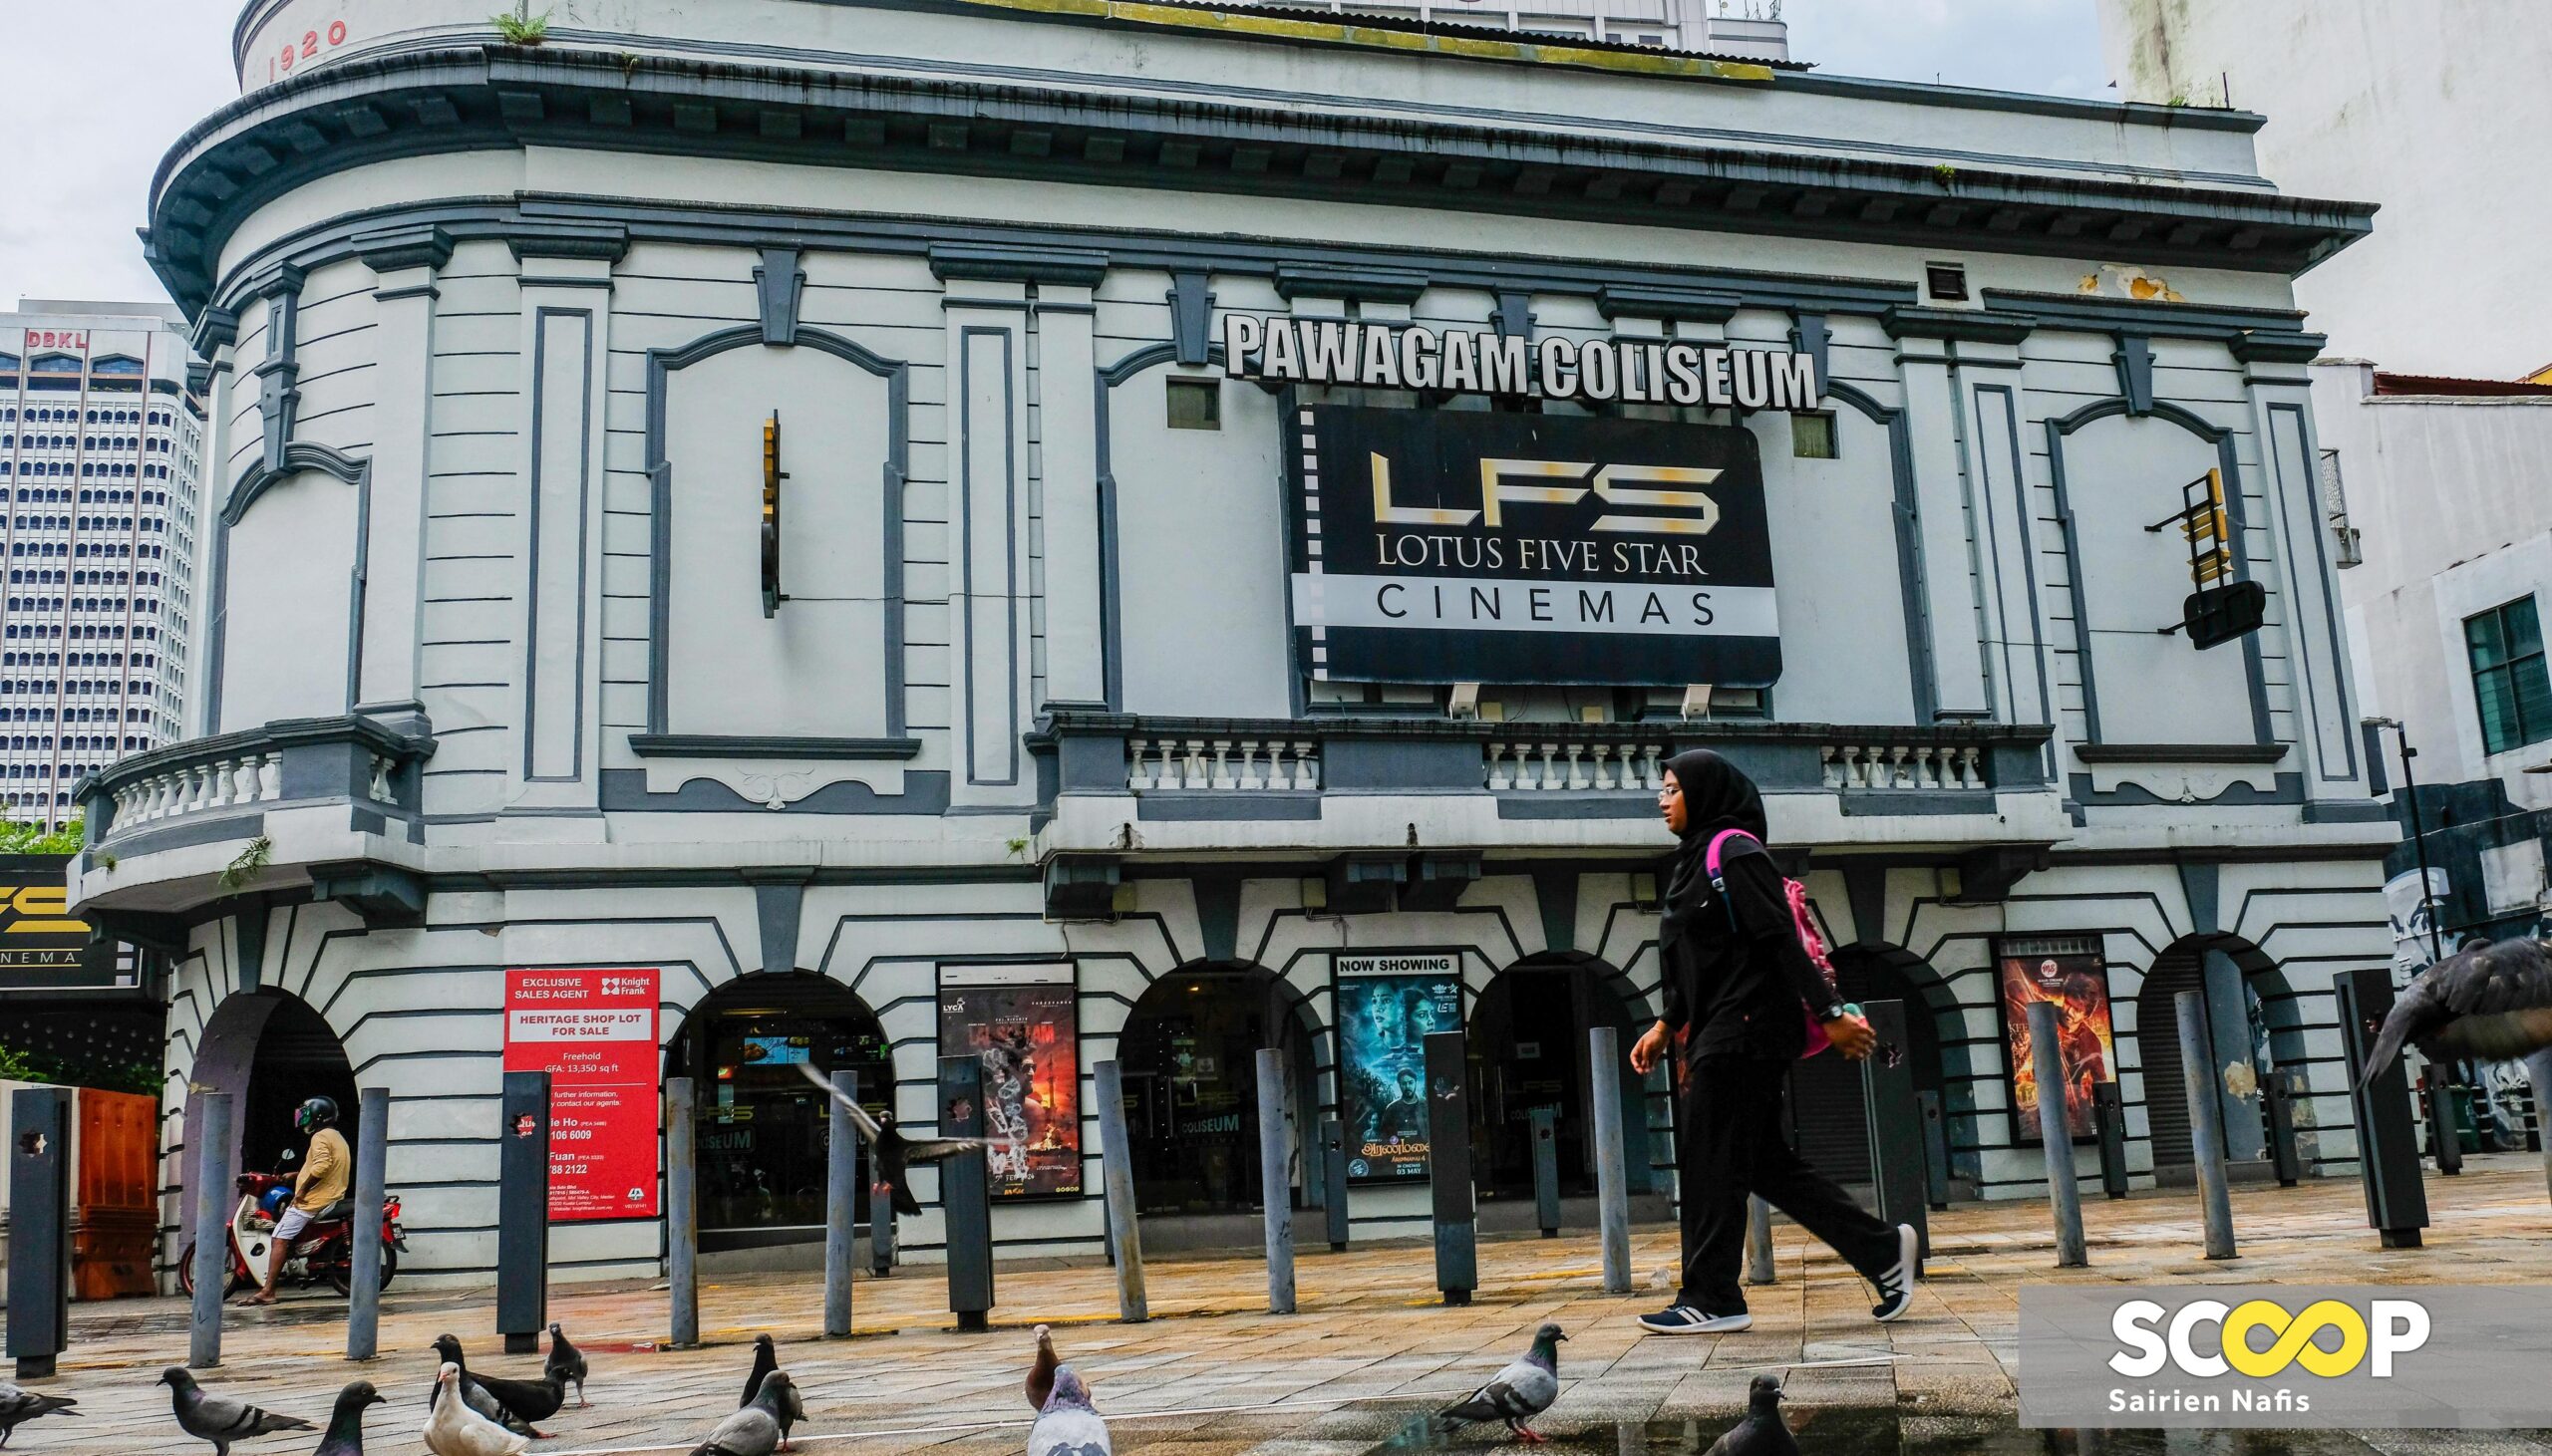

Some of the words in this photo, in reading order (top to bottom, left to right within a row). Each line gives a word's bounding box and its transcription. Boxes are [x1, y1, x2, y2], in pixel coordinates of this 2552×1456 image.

[269, 20, 346, 83] 1920
[27, 331, 87, 349] DBKL
[1223, 314, 1528, 396] PAWAGAM
[1538, 336, 1821, 412] COLISEUM
[1371, 450, 1725, 536] LFS
[1376, 533, 1504, 569] LOTUS
[1518, 538, 1599, 572] FIVE
[1612, 542, 1709, 577] STAR
[1377, 582, 1716, 627] CINEMAS
[1339, 960, 1375, 972] NOW
[1379, 959, 1450, 971] SHOWING
[522, 978, 582, 988] EXCLUSIVE
[621, 977, 650, 988] Knight
[514, 990, 549, 1000] SALES
[551, 990, 589, 1000] AGENT
[519, 1015, 580, 1024] HERITAGE
[583, 1015, 615, 1023] SHOP
[619, 1014, 642, 1022] LOT
[552, 1026, 576, 1035] FOR
[579, 1026, 610, 1035] SALE
[563, 1051, 601, 1061] Freehold
[567, 1064, 597, 1073] 13,350
[562, 1117, 578, 1127] Ho
[1181, 1113, 1240, 1134] COLISEUM
[569, 1129, 592, 1140] 6009
[549, 1151, 575, 1161] Fuan
[565, 1164, 587, 1174] 2122
